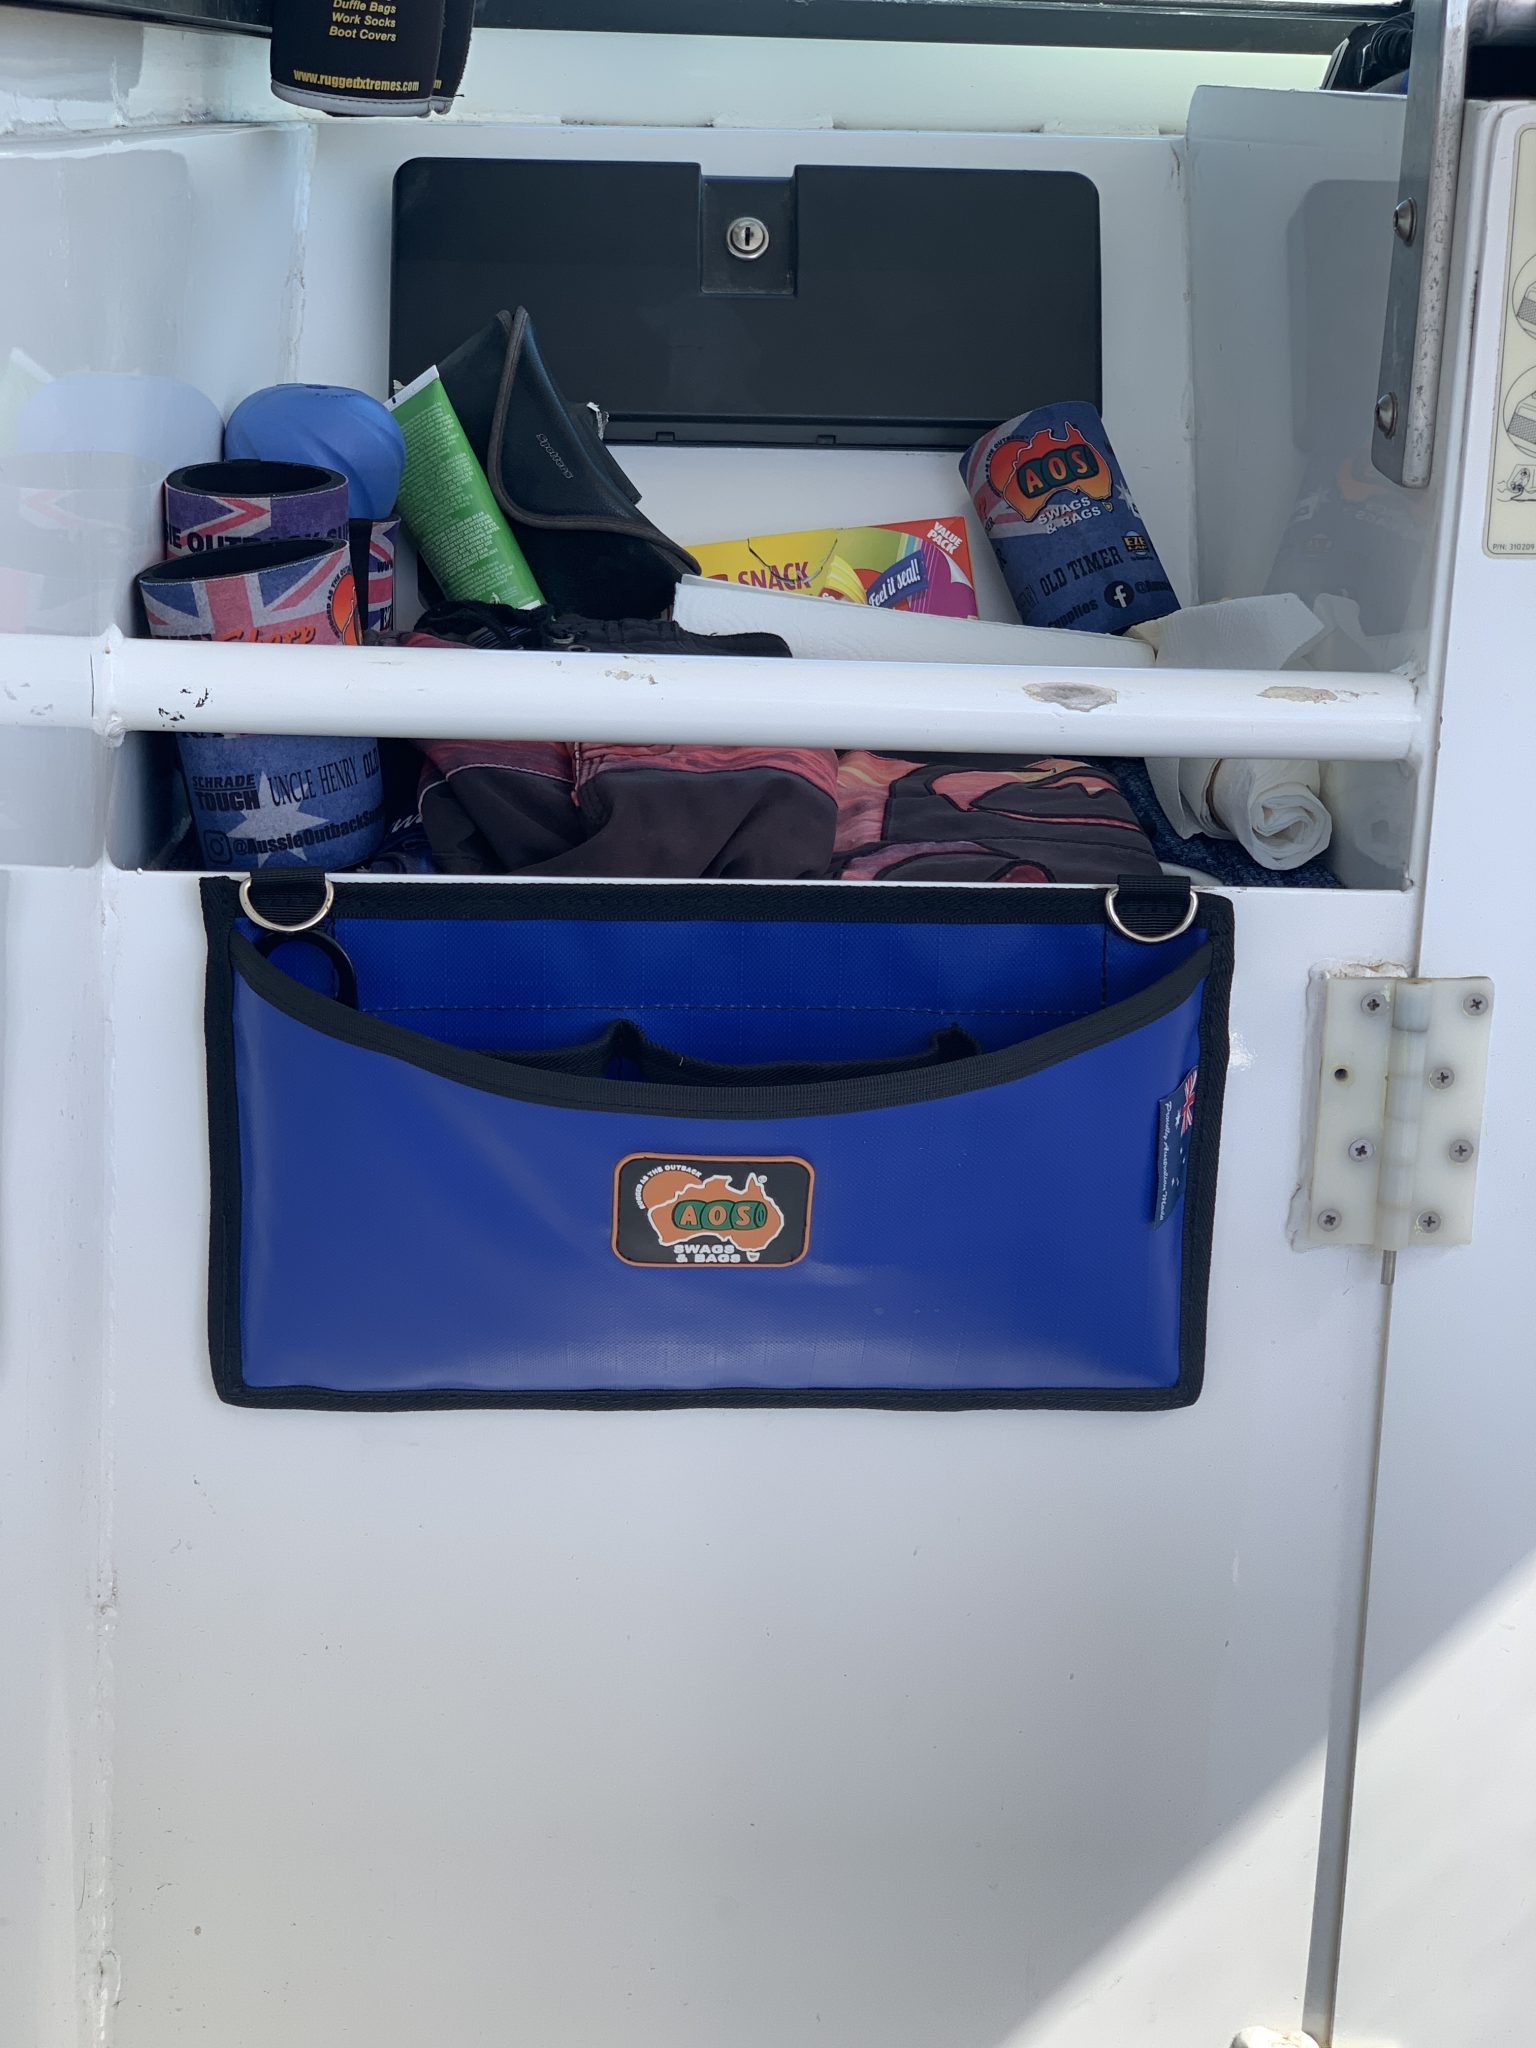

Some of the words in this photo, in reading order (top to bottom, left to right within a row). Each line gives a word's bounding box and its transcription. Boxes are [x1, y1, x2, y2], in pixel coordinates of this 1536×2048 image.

[369, 1, 397, 15] Bags
[332, 12, 361, 25] Work
[364, 15, 396, 28] Socks
[329, 26, 357, 38] Boot
[359, 30, 397, 42] Covers
[1026, 450, 1090, 494] AOS
[1037, 496, 1092, 526] SWAGS
[1046, 522, 1057, 535] &
[1061, 507, 1102, 530] BAGS
[926, 529, 957, 555] PACK
[933, 521, 963, 547] VALUE
[737, 561, 813, 592] SNACK
[1039, 570, 1068, 598] OLD
[1067, 545, 1124, 582] TIMER
[886, 577, 896, 597] it
[192, 774, 256, 789] SCHRADE
[268, 769, 317, 807] UNCLE
[317, 756, 360, 794] HENRY
[195, 790, 261, 812] TOUGH
[647, 1166, 664, 1177] THE
[664, 1164, 702, 1178] OUTBACK
[674, 1244, 735, 1254] SWAGS
[694, 1254, 741, 1263] BAGS
